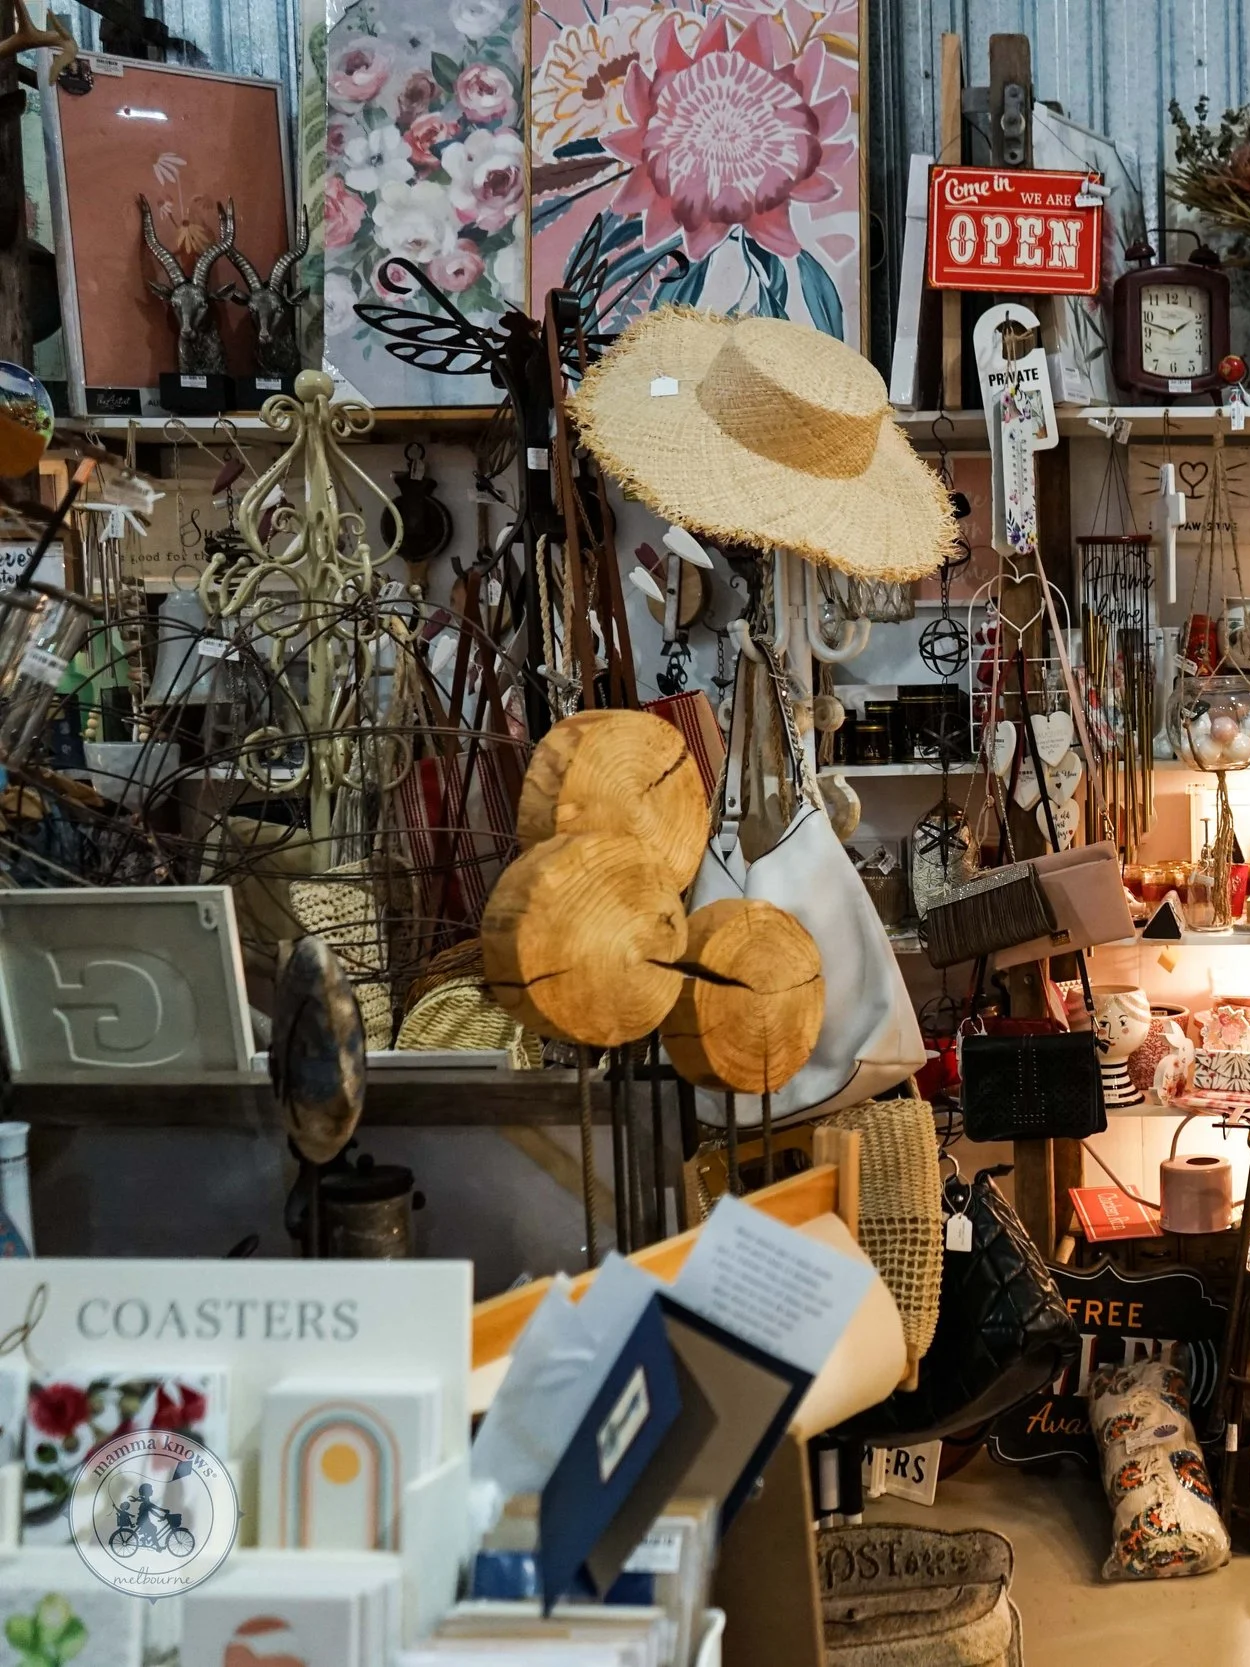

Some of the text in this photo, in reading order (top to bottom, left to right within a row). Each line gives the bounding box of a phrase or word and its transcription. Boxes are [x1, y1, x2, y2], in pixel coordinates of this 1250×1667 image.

[945, 174, 1015, 205] Come in
[1020, 192, 1072, 206] WE ARE
[947, 212, 1083, 269] OPEN
[1149, 293, 1159, 306] 11
[1166, 293, 1179, 305] 12
[1187, 296, 1192, 308] 1
[1143, 311, 1154, 323] 10
[1195, 313, 1203, 325] 2
[1144, 327, 1152, 338] 9
[1195, 328, 1203, 340] 3
[1144, 342, 1153, 354] 8
[1196, 344, 1203, 356] 4
[1152, 359, 1159, 371] 7
[1170, 362, 1177, 374] 6
[1188, 361, 1196, 373] 5
[166, 552, 187, 562] for
[1066, 1298, 1144, 1329] FREE
[76, 1298, 360, 1342] COASTERS
